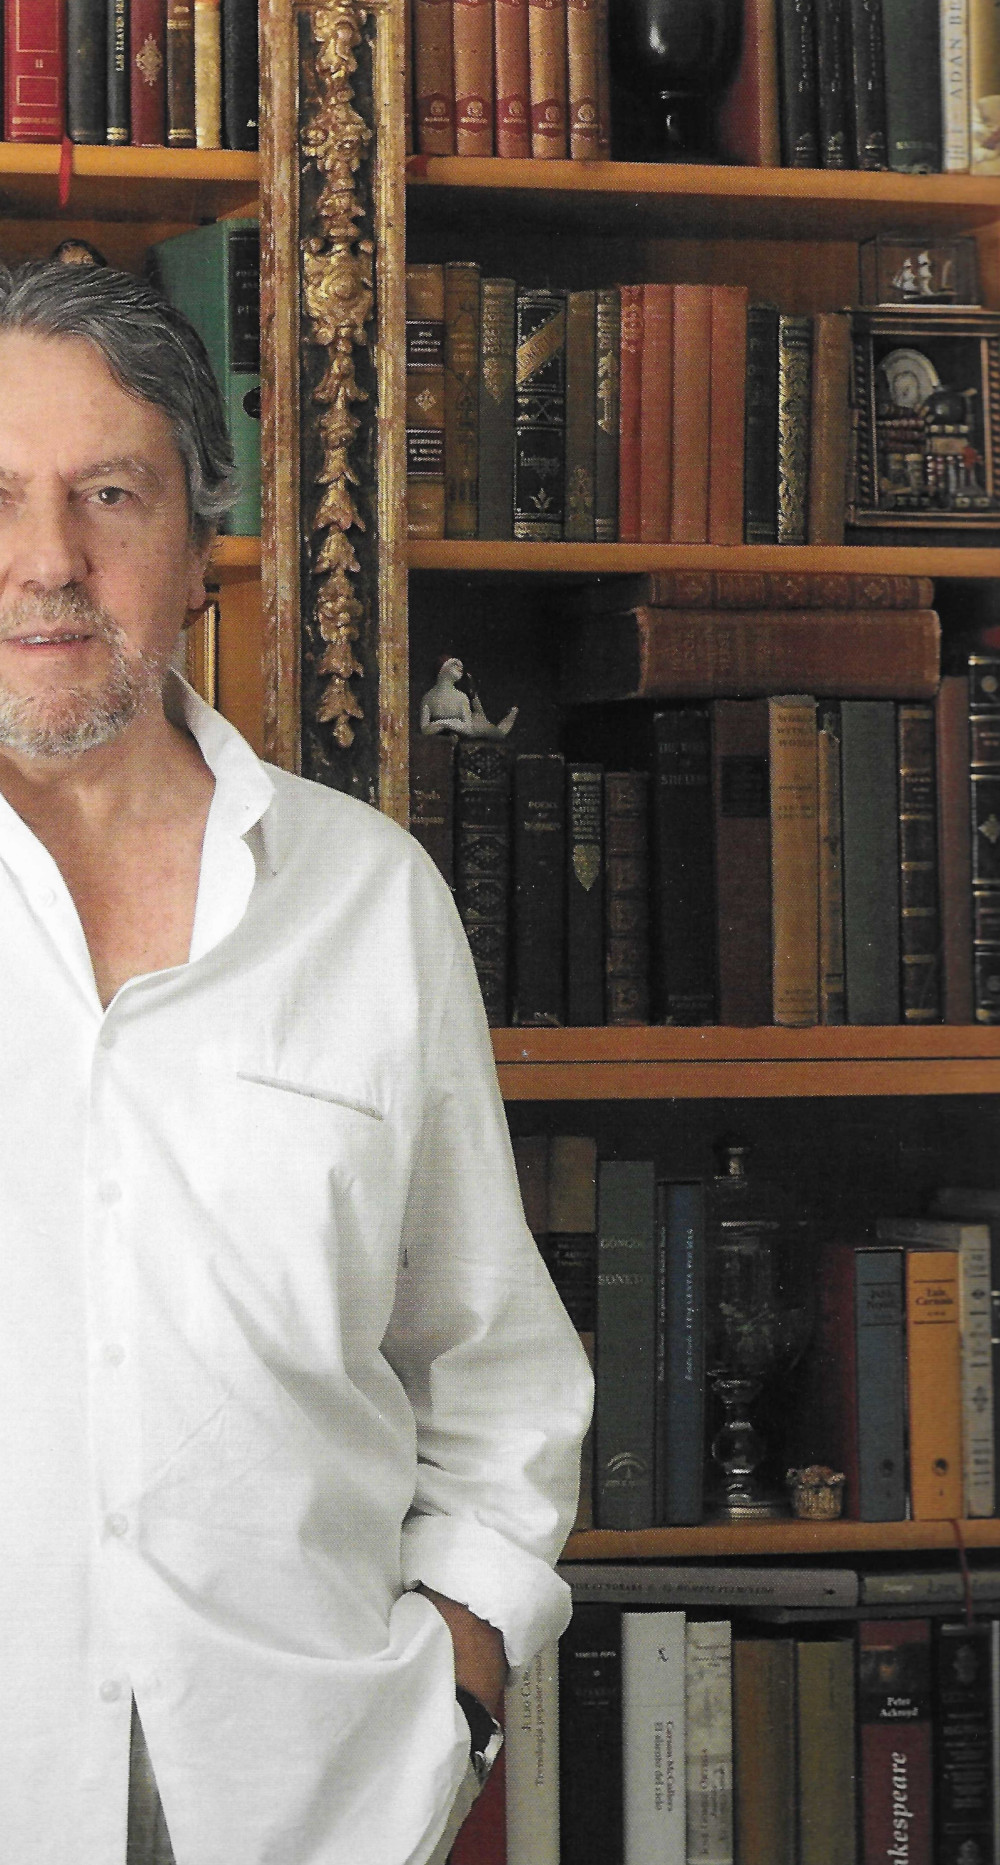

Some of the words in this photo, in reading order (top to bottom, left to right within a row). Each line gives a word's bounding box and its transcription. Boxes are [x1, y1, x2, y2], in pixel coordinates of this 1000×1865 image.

[949, 39, 963, 100] ADAN
[879, 1706, 919, 1718] Ackroyd
[886, 1697, 911, 1706] Peter
[665, 1760, 675, 1812] McCullers
